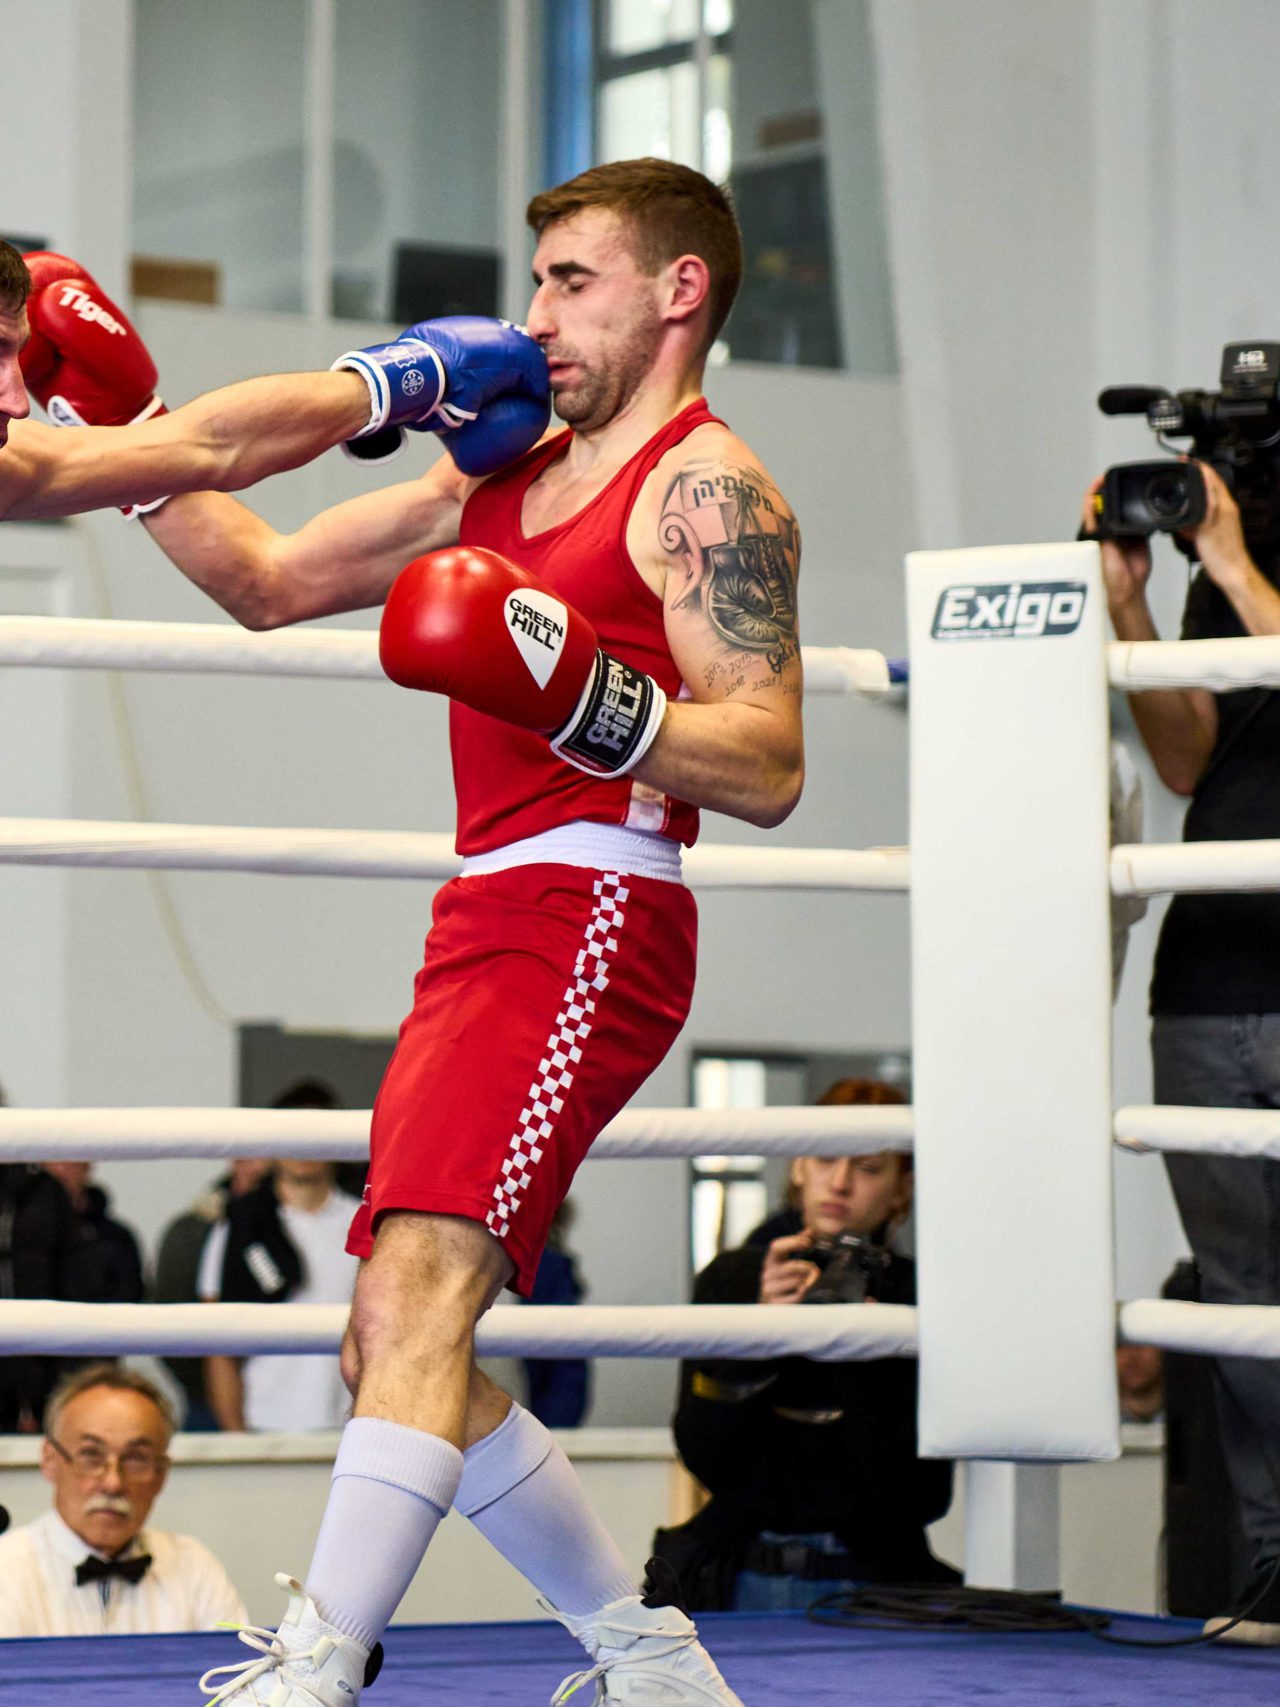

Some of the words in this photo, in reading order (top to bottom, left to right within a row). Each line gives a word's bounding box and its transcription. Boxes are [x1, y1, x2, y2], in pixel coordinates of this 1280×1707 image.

[509, 598, 563, 638] GREEN
[510, 611, 555, 651] HILL
[939, 582, 1084, 636] Exigo
[586, 658, 624, 744] GREEN
[602, 681, 642, 752] HILL
